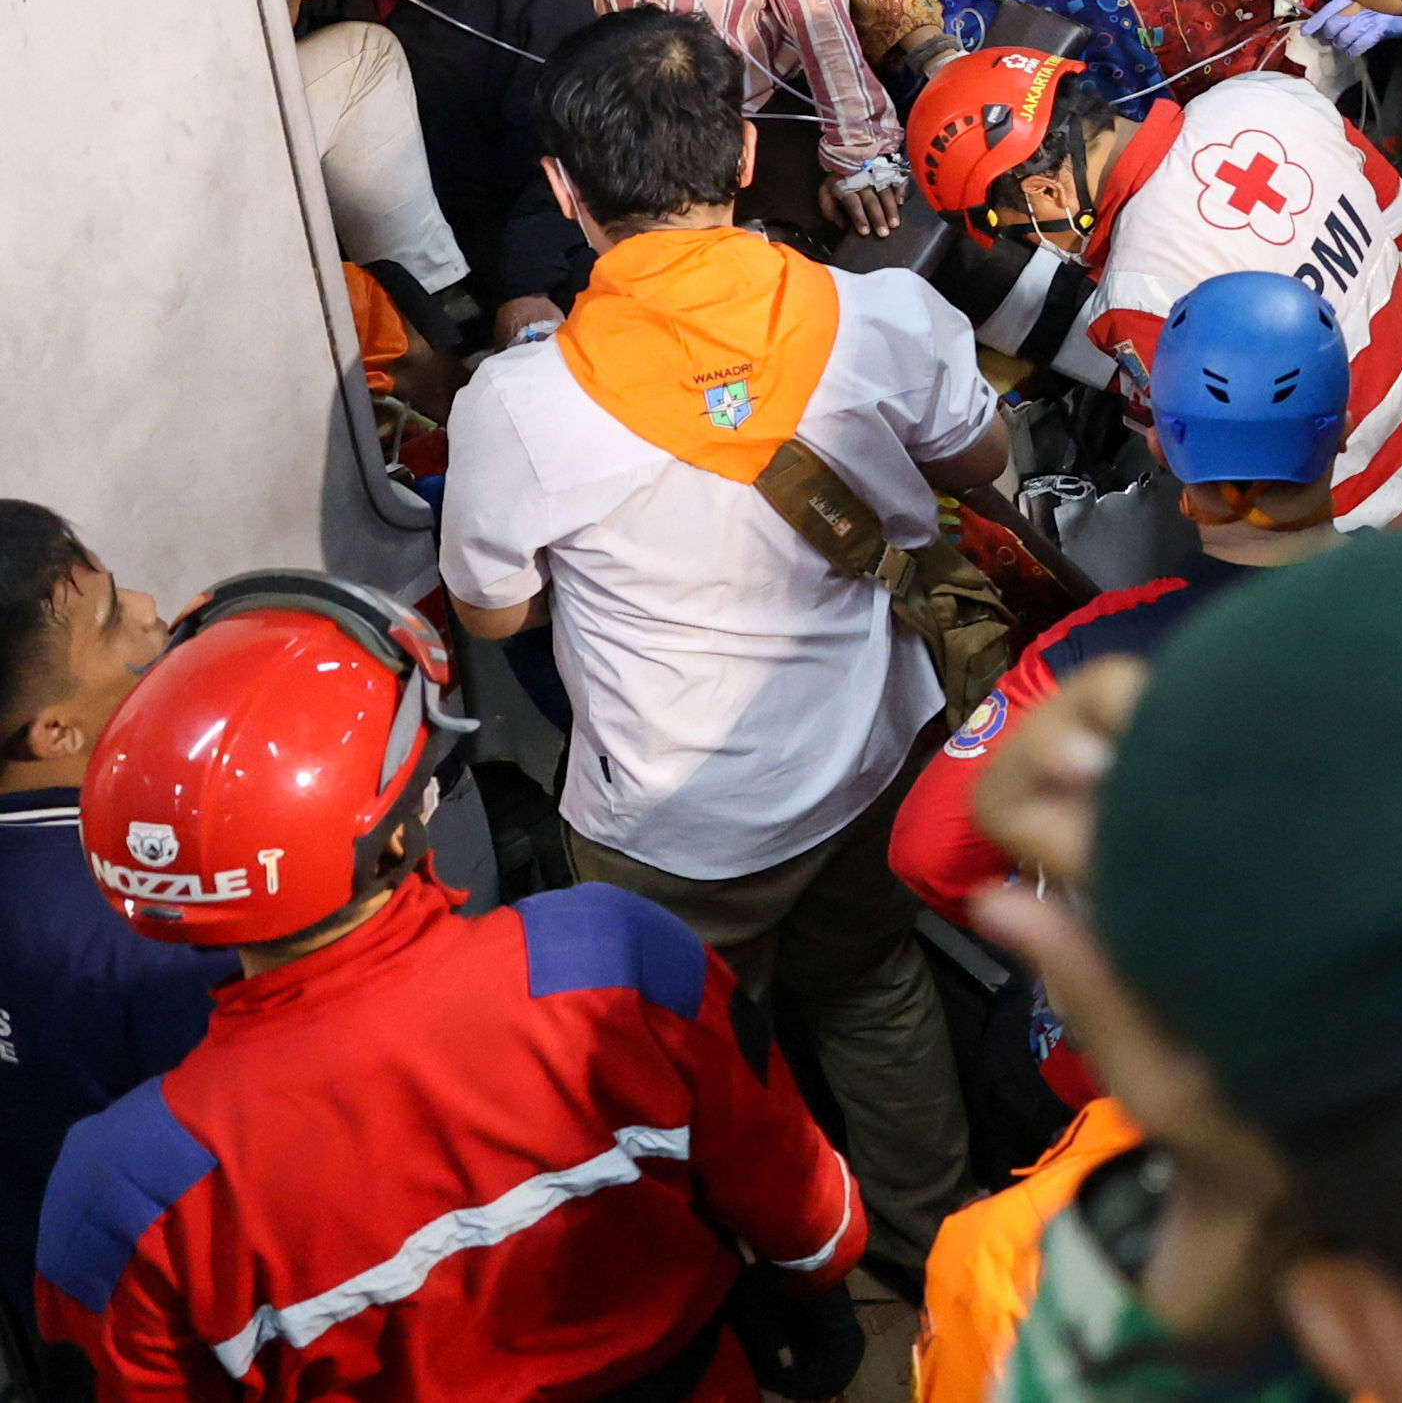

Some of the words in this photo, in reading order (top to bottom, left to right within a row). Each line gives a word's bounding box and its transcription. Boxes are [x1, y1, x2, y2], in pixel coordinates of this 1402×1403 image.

[1018, 65, 1055, 123] JAKARTA
[1292, 193, 1373, 296] PMI
[90, 851, 252, 903] NOZZLE
[256, 847, 285, 895] T
